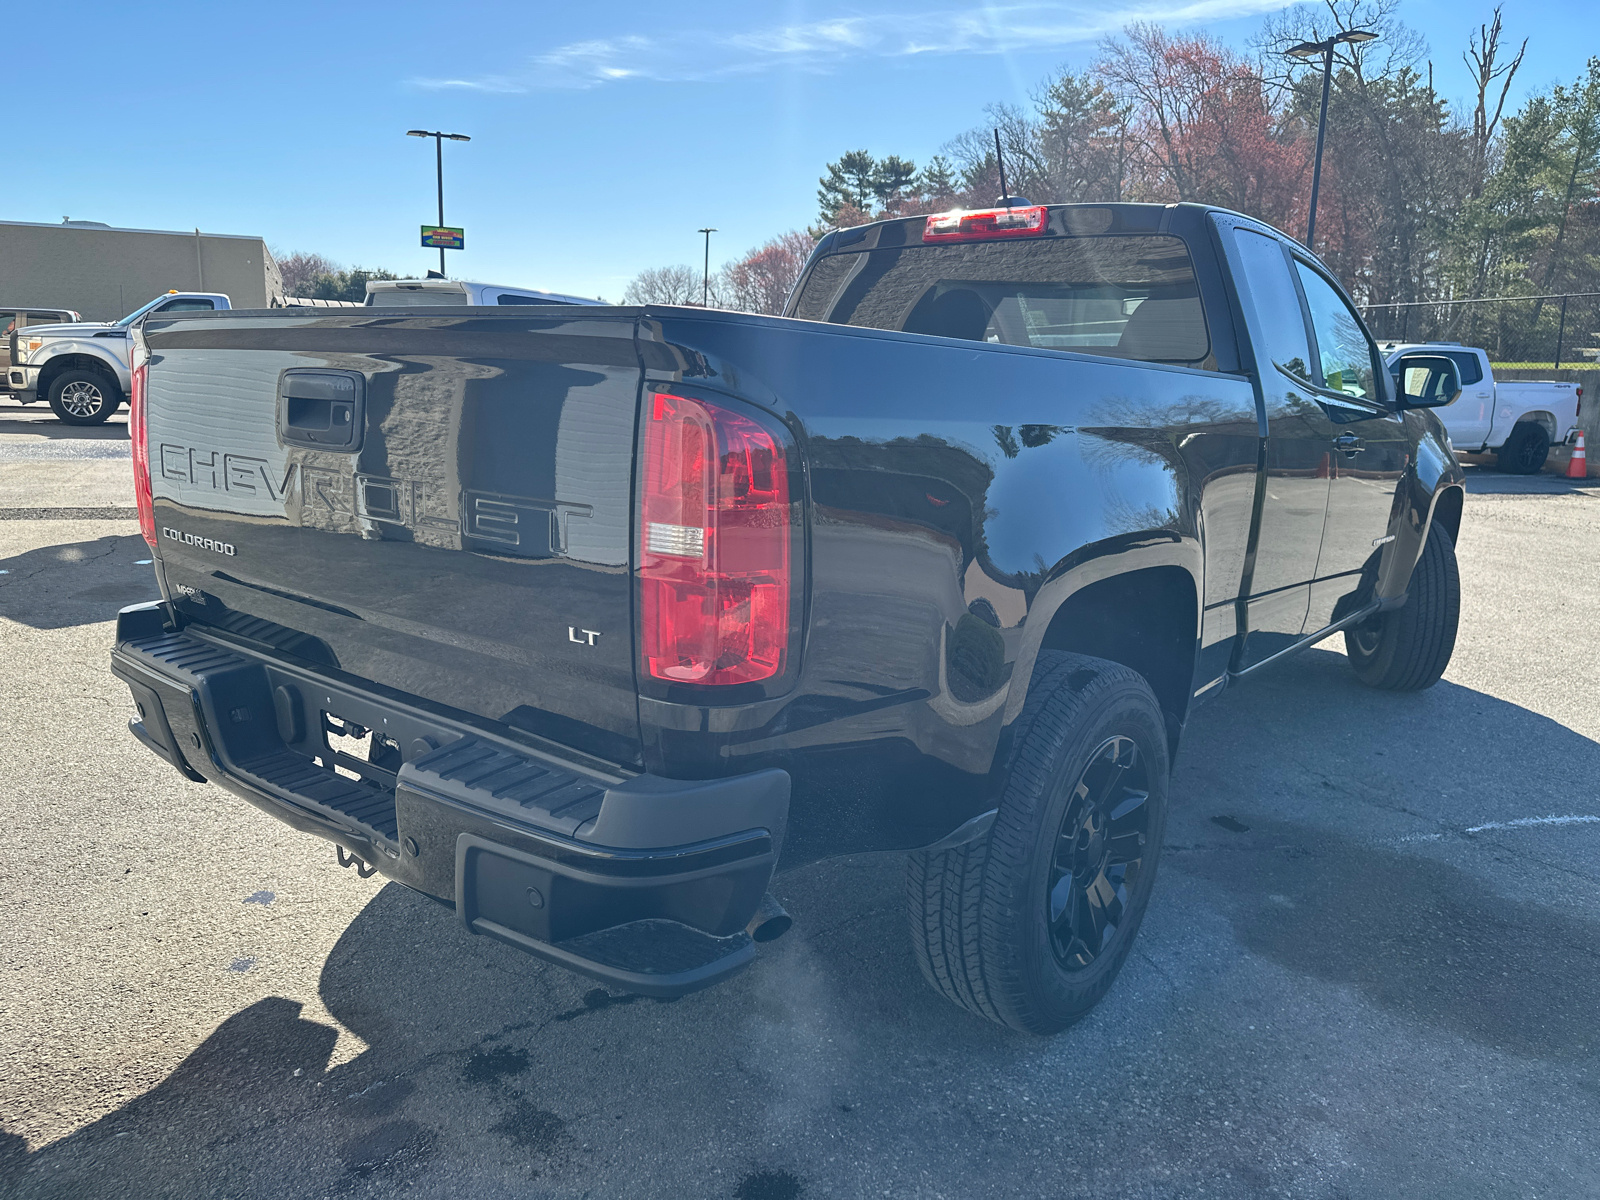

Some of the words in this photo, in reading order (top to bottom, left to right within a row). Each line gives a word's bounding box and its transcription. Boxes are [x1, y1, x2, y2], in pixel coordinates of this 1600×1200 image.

[161, 443, 594, 554] CHEVROLET
[163, 526, 236, 556] COLORADO
[568, 626, 601, 646] LT
